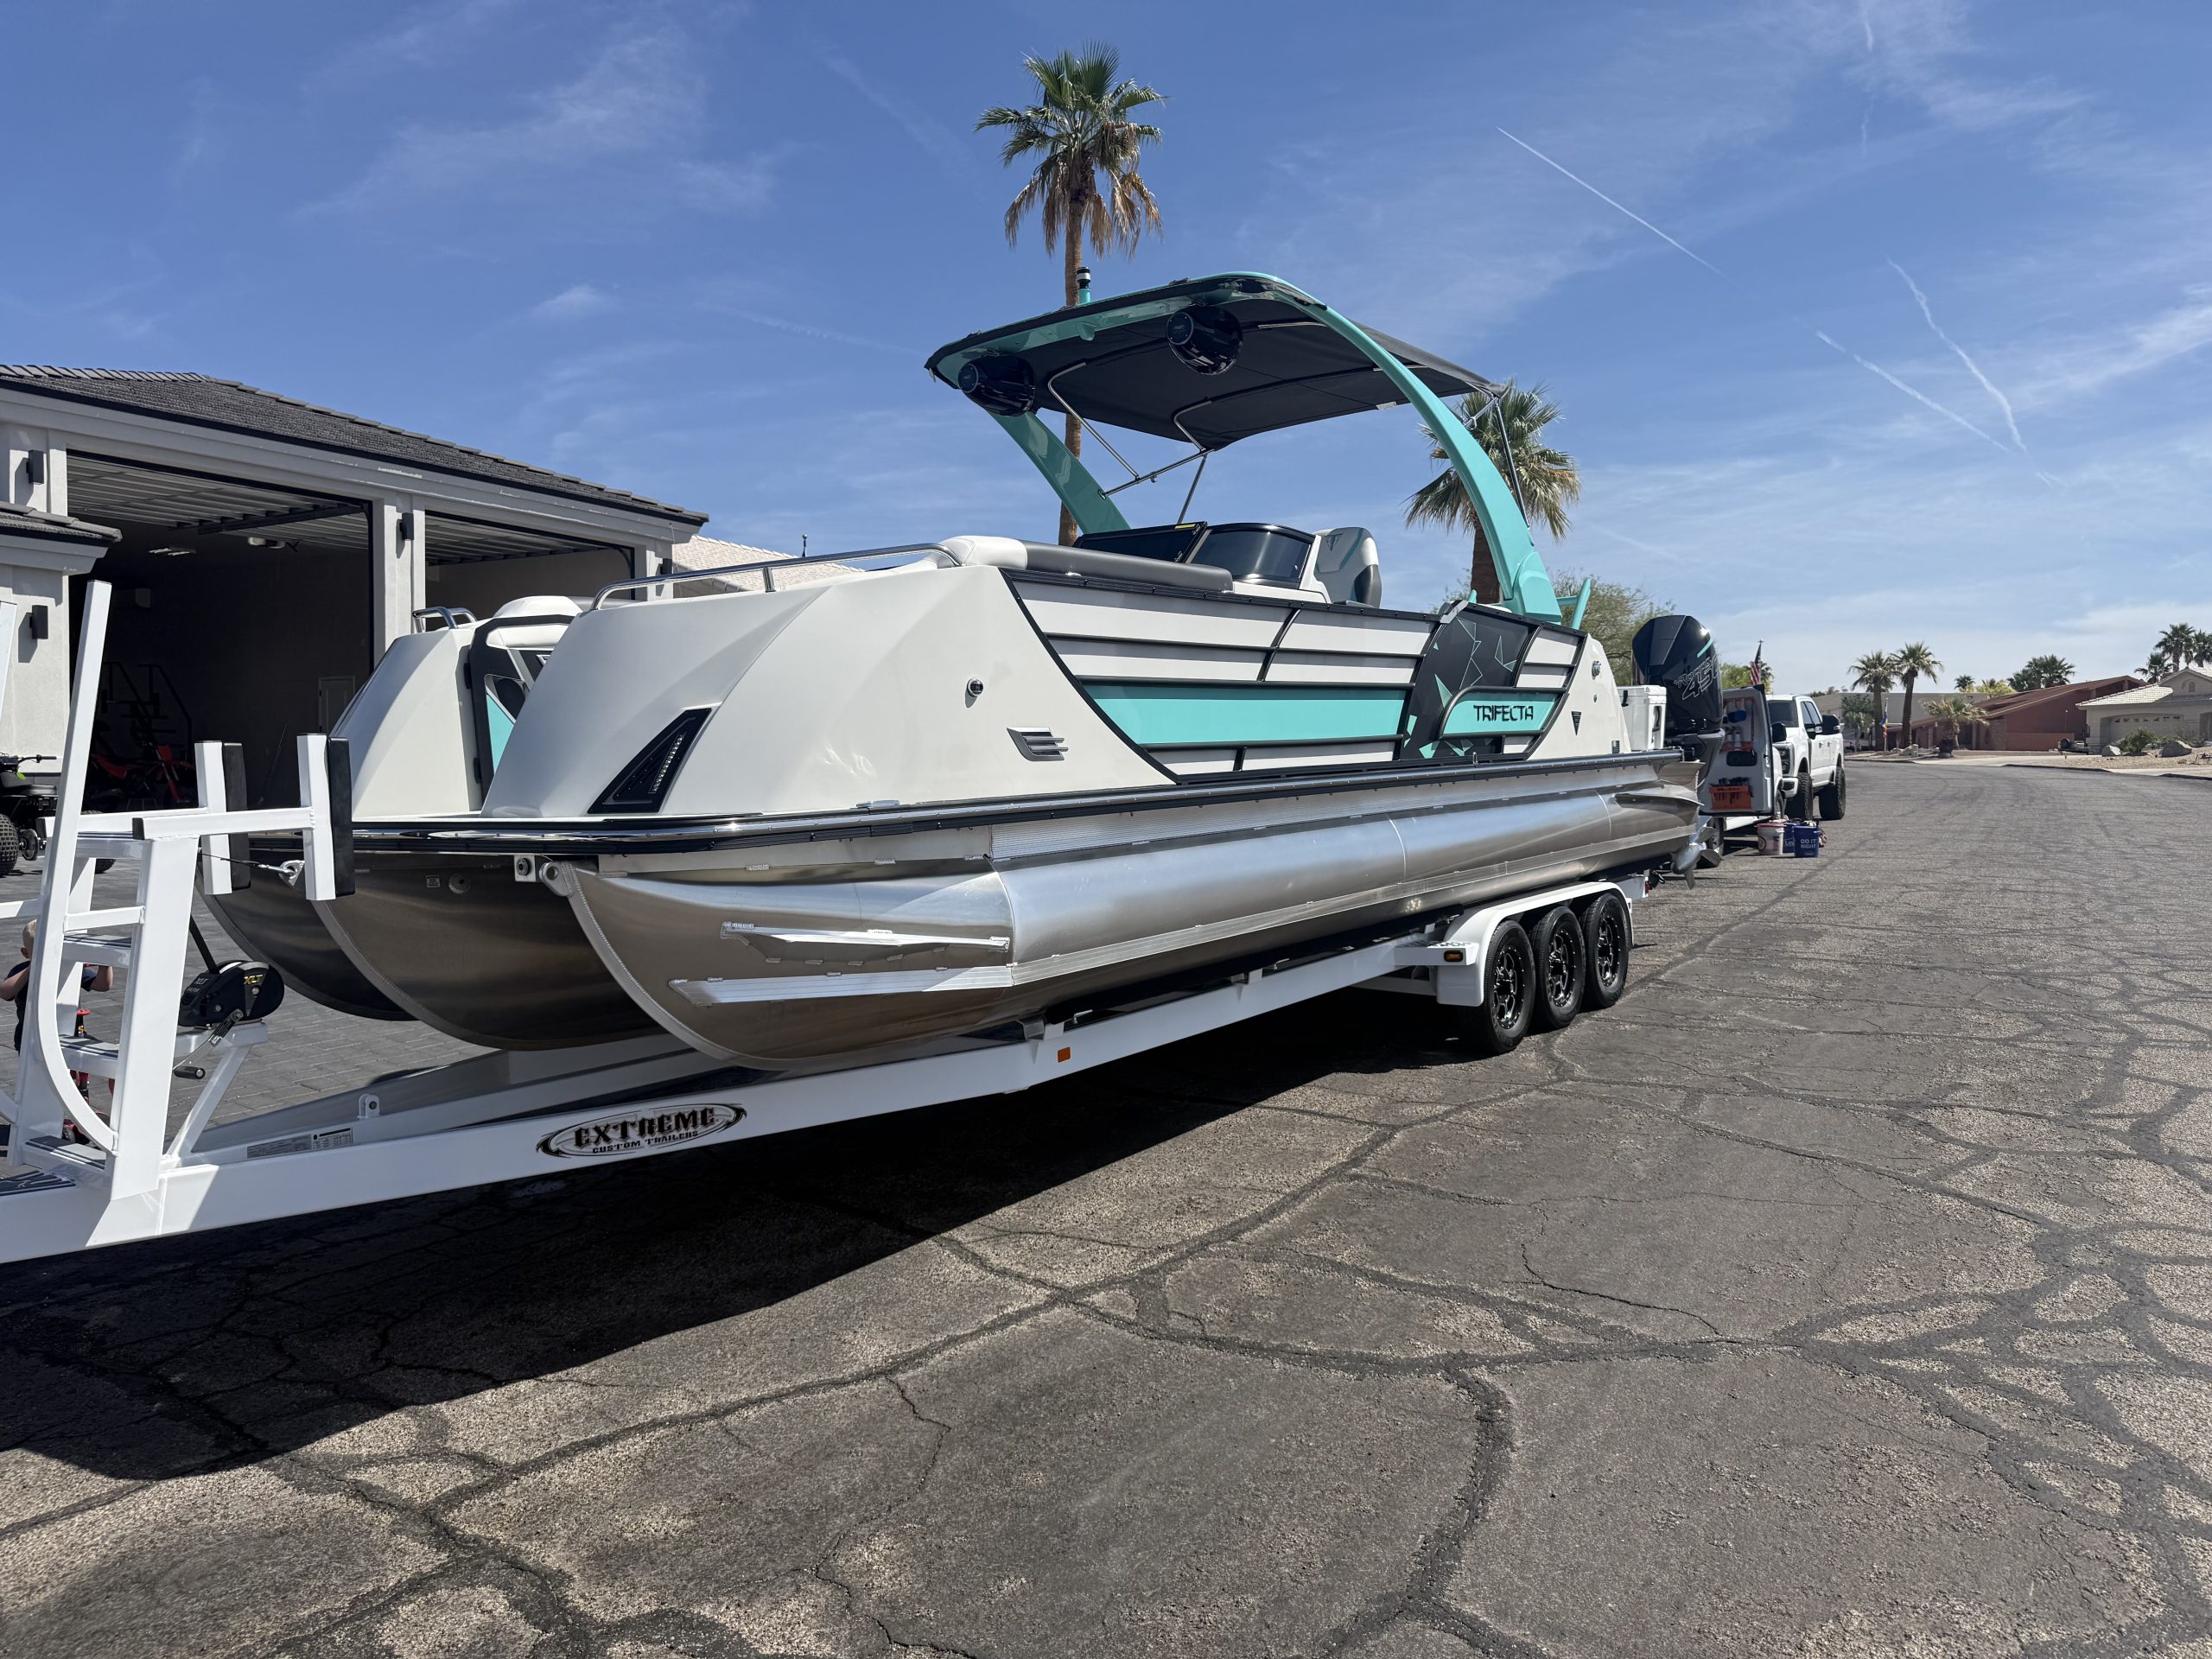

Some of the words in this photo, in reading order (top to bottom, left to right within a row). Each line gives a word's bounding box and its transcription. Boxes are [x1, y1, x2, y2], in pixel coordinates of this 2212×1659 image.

[1473, 705, 1534, 721] TRIFECTA
[243, 974, 264, 985] XLT
[574, 1107, 715, 1148] EXTREME
[592, 1140, 641, 1154] CUSTOM
[645, 1130, 699, 1145] TRAILERS
